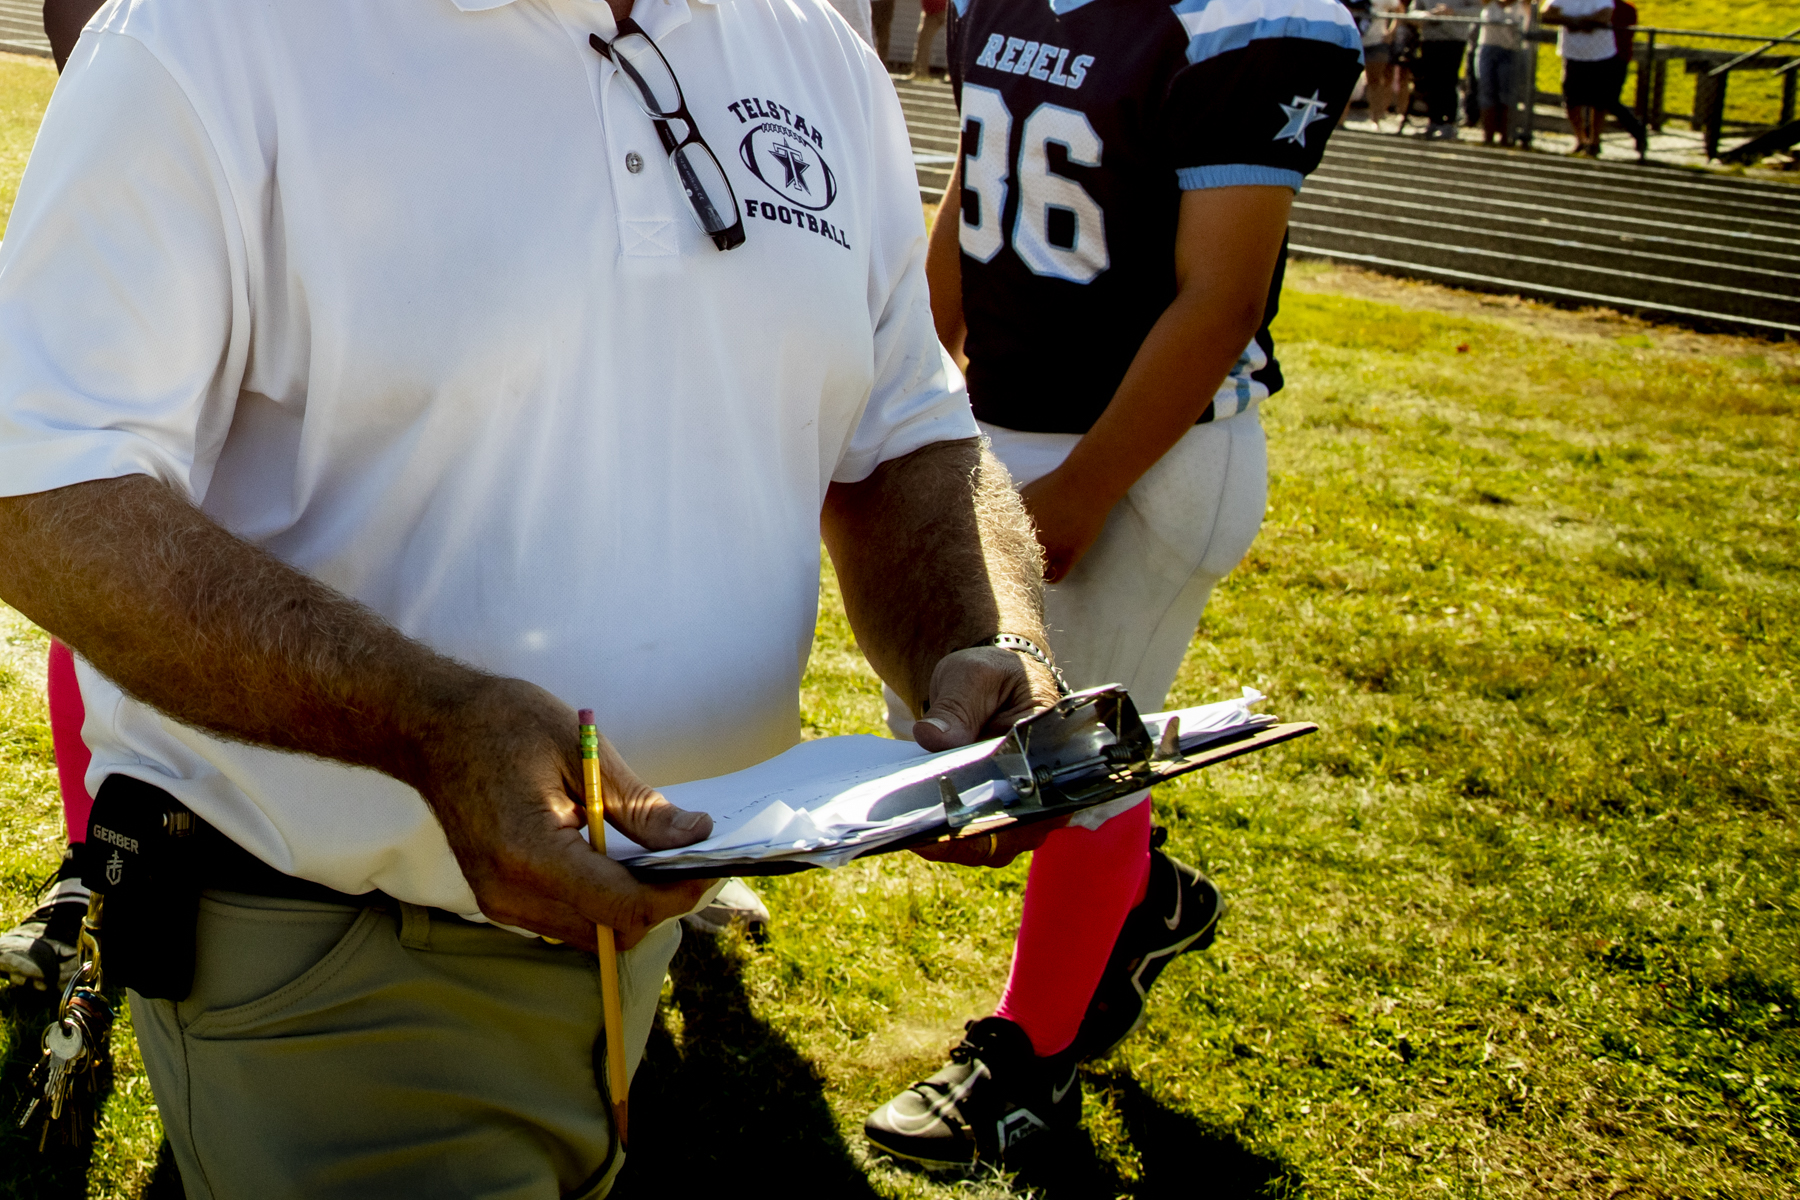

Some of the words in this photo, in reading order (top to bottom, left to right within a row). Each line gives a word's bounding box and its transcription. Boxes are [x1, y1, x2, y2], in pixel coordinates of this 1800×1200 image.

[976, 33, 1095, 90] REBELS
[727, 97, 823, 150] TELSTAR
[959, 82, 1110, 285] 36
[744, 199, 851, 250] FOOTBALL
[93, 824, 139, 854] GERBER
